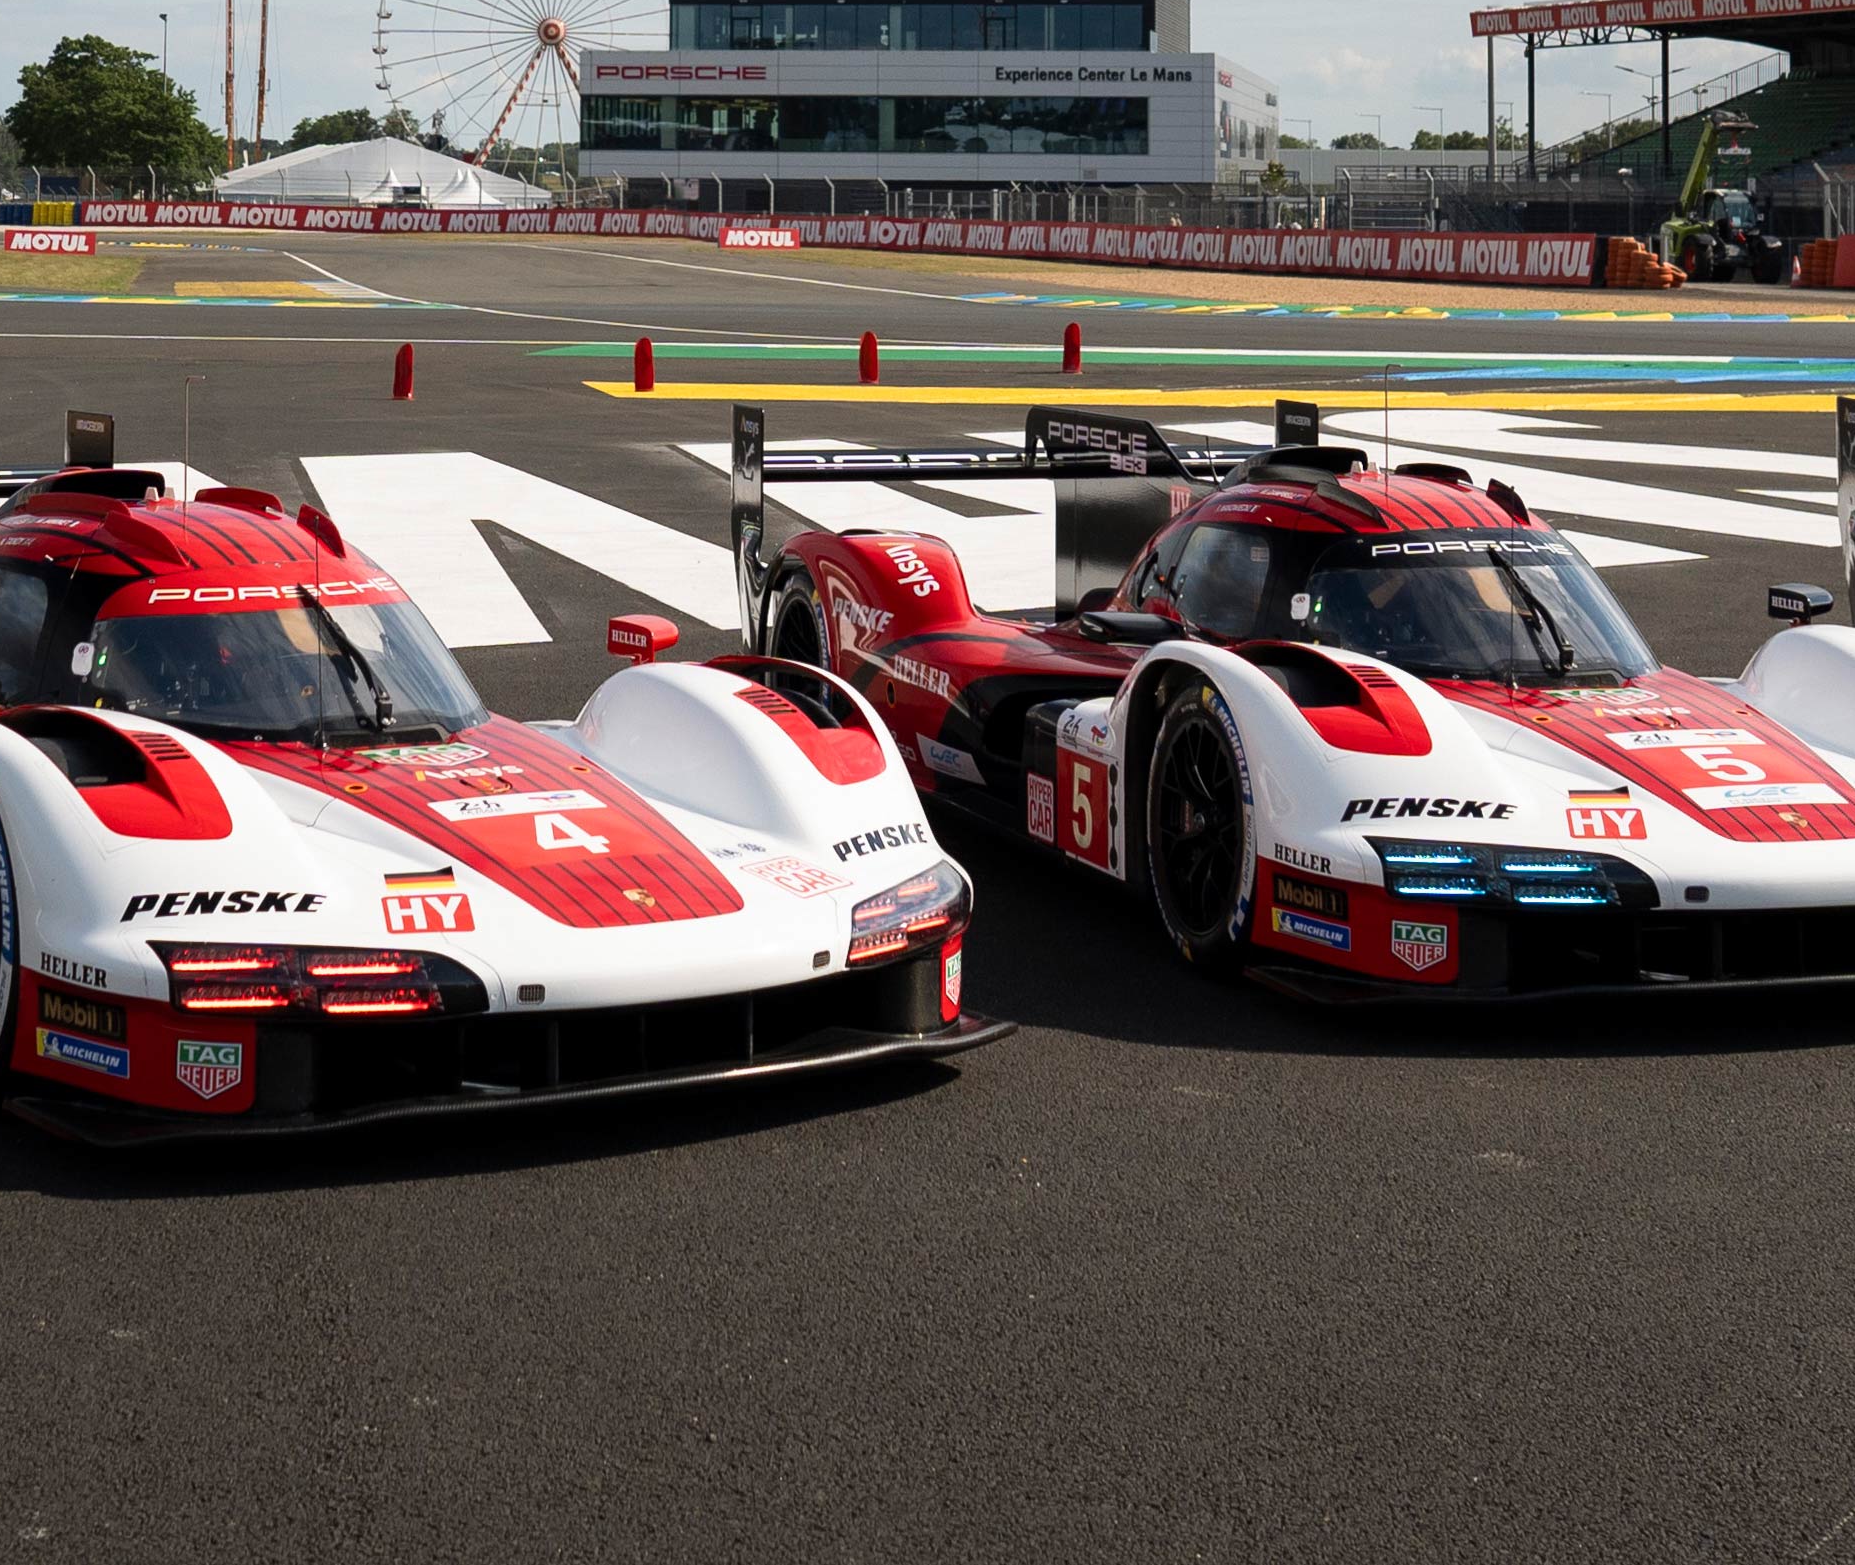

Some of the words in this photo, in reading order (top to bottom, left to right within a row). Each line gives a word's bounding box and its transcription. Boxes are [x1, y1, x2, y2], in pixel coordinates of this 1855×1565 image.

[1477, 13, 1513, 33] MOTUL
[1518, 9, 1555, 30] MOTUL
[1561, 5, 1600, 27] MOTUL
[1606, 1, 1647, 24] MOTUL
[597, 66, 767, 80] PORSCHE
[996, 67, 1073, 84] Experience
[1078, 67, 1125, 82] Center
[1131, 68, 1147, 82] Le
[1153, 68, 1192, 82] Mans
[11, 233, 89, 252] MOTUL
[85, 204, 148, 223] MOTUL
[154, 205, 221, 225] MOTUL
[229, 207, 297, 227] MOTUL
[304, 210, 374, 230] MOTUL
[381, 212, 442, 232] MOTUL
[448, 212, 500, 233] MOTUL
[506, 212, 550, 233] MOTUL
[554, 213, 596, 233] MOTUL
[601, 213, 640, 234] MOTUL
[644, 214, 684, 234] MOTUL
[825, 220, 867, 244] MOTUL
[923, 222, 963, 248] MOTUL
[966, 224, 1004, 250] MOTUL
[1008, 225, 1046, 252] MOTUL
[1050, 226, 1089, 254] MOTUL
[1092, 228, 1130, 258] MOTUL
[1181, 233, 1225, 263] MOTUL
[1229, 235, 1278, 266] MOTUL
[1280, 234, 1333, 268] MOTUL
[1336, 237, 1392, 270] MOTUL
[1396, 238, 1456, 273] MOTUL
[1460, 240, 1520, 276] MOTUL
[1525, 241, 1591, 279] MOTUL
[726, 230, 795, 247] MOTUL
[1048, 420, 1148, 455] PORSCHE
[1109, 453, 1148, 475] 963
[1372, 540, 1573, 558] PORSCHE
[878, 541, 941, 598] Ansys
[147, 576, 399, 605] PORSCHE
[1771, 596, 1804, 613] HELLER
[832, 596, 894, 634] PENSKE
[611, 628, 647, 648] HELLER
[893, 655, 951, 698] HELLER
[1214, 708, 1250, 794] MICHELIN
[1681, 746, 1767, 782] 5
[1028, 777, 1052, 805] HYPER
[1724, 784, 1800, 799] WEC
[1028, 802, 1052, 841] CAR
[1072, 763, 1093, 850] 5
[1340, 798, 1519, 823] PENSKE
[533, 812, 611, 854] 4
[1574, 809, 1638, 838] HY
[832, 823, 928, 862] PENSKE
[1274, 842, 1332, 875] HELLER
[773, 868, 843, 894] CAR
[1277, 879, 1322, 910] Mobil
[120, 890, 328, 923] PENSKE
[386, 894, 464, 931] HY
[1294, 921, 1344, 943] MICHELIN
[1396, 924, 1442, 942] TAG
[40, 951, 107, 988] HELLER
[1394, 942, 1447, 968] HEUER
[44, 992, 97, 1026] Mobil
[62, 1043, 121, 1068] MICHELIN
[182, 1044, 237, 1065] TAG
[180, 1066, 239, 1100] HEUER
